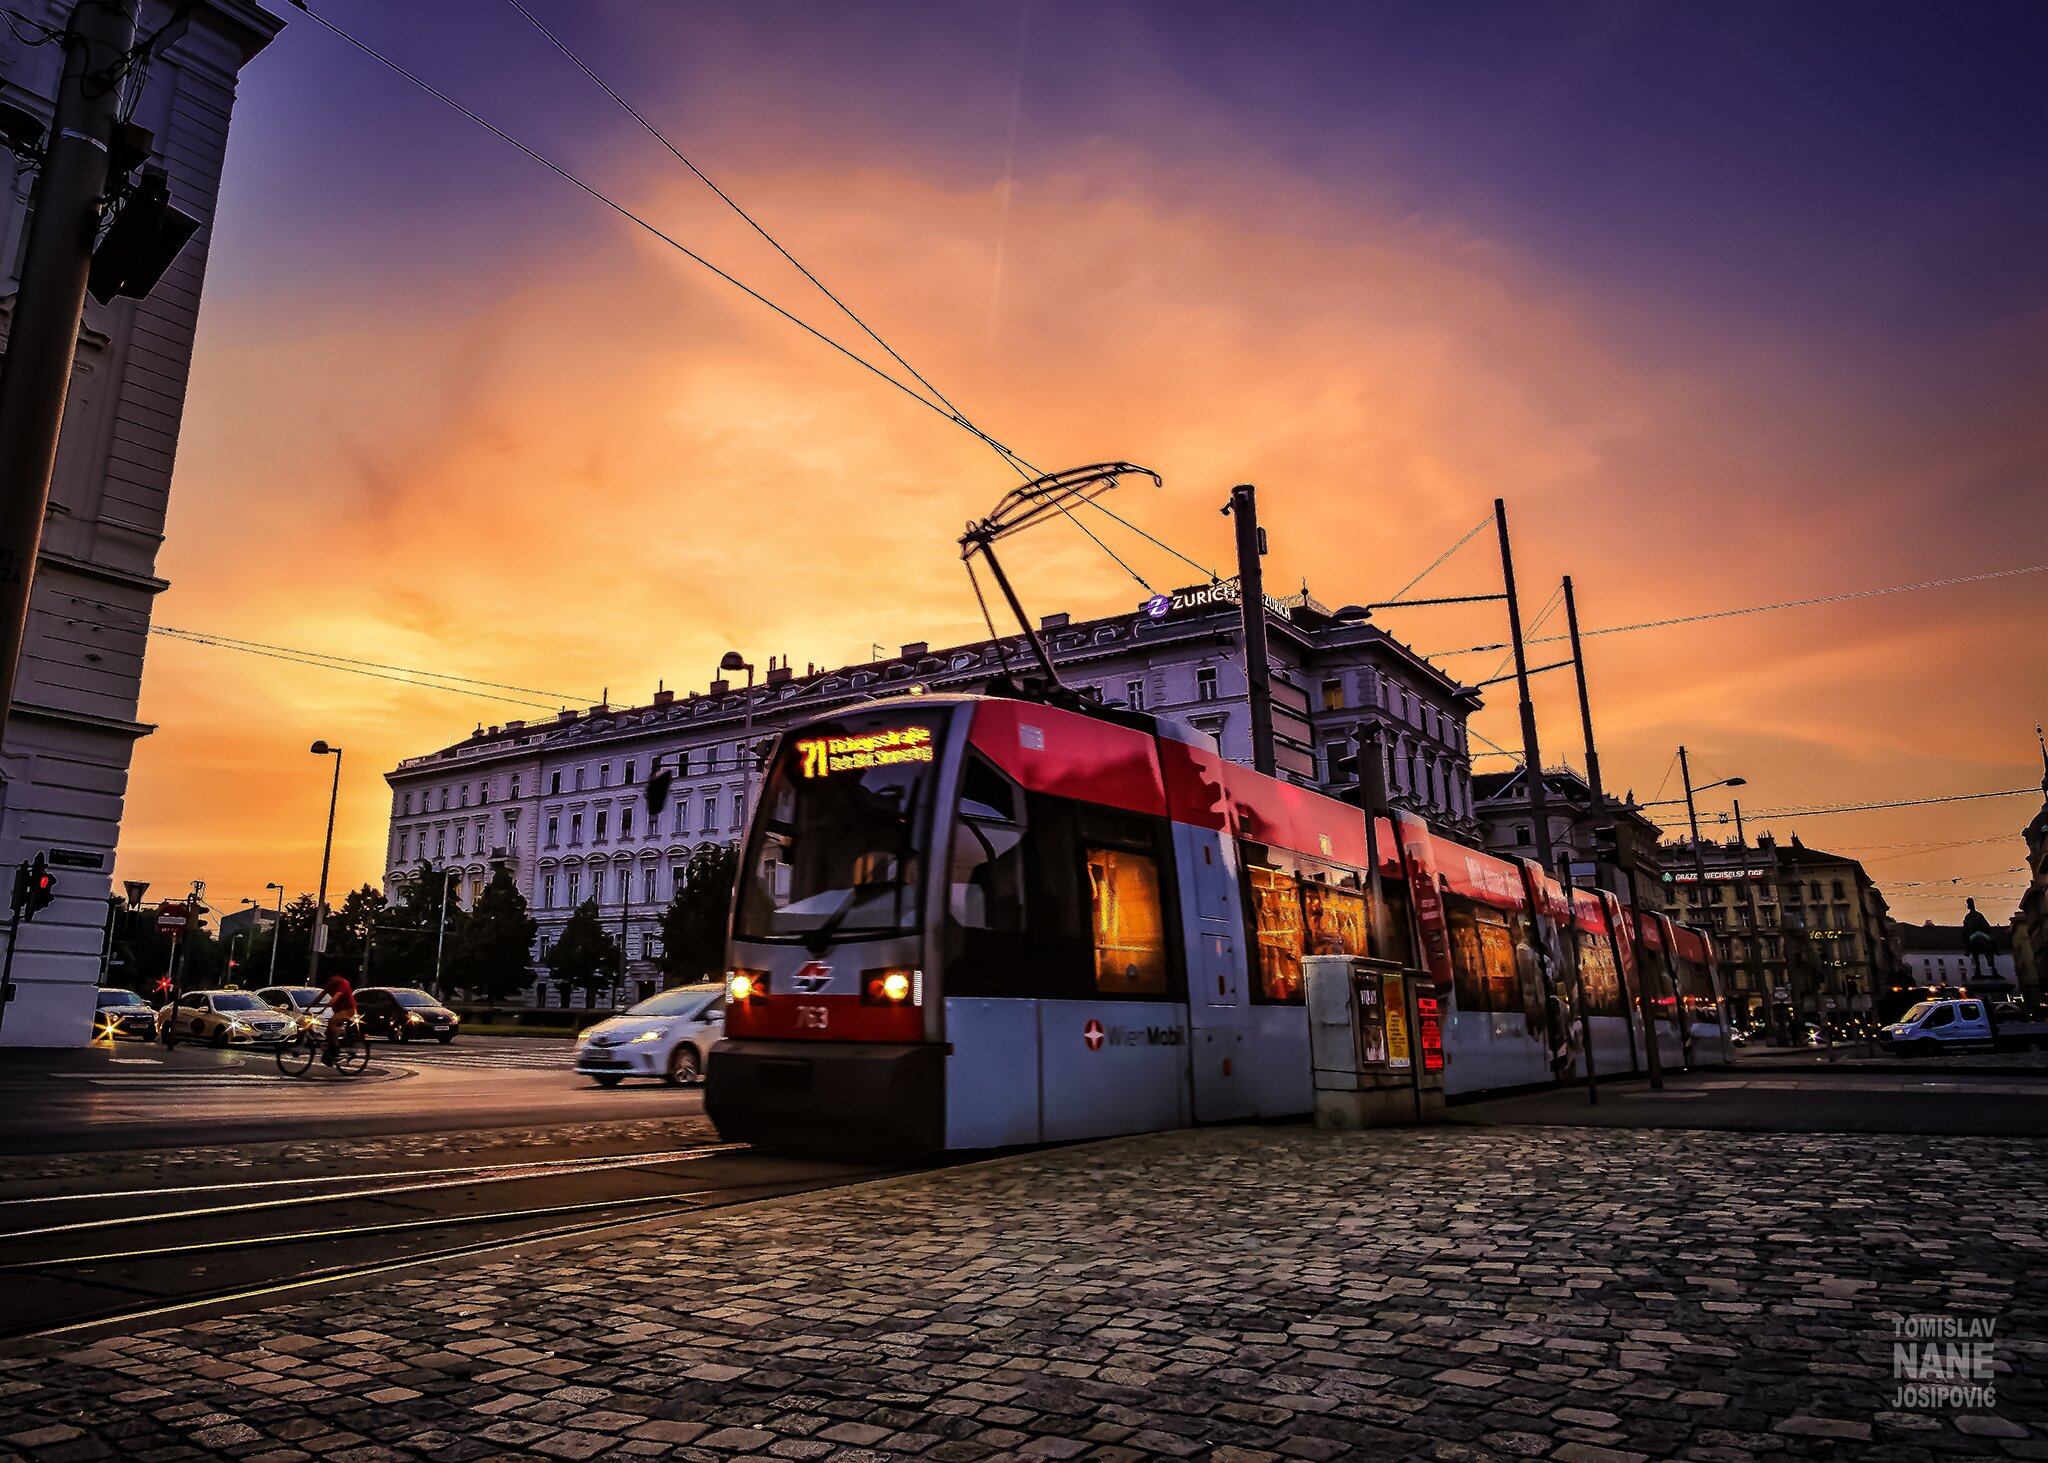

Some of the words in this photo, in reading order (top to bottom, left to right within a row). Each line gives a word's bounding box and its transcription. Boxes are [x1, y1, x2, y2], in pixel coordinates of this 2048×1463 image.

[1172, 586, 1237, 610] ZURICH
[1264, 593, 1291, 621] ZURICH
[797, 740, 828, 778] 71
[1675, 872, 1699, 881] GRAZE
